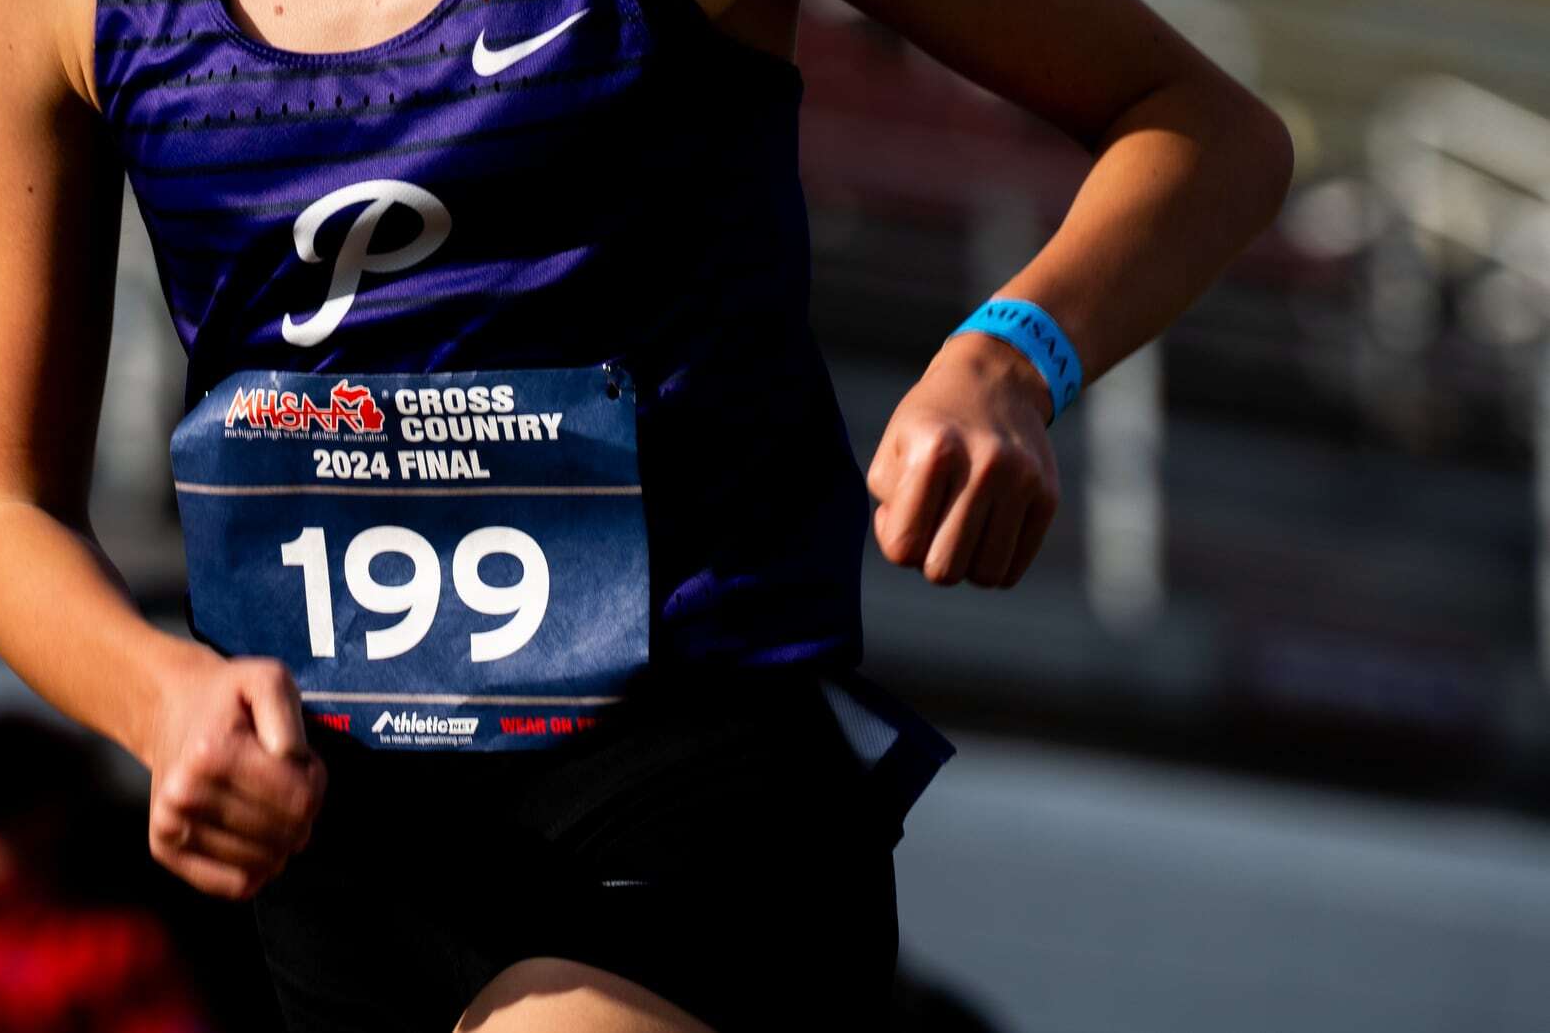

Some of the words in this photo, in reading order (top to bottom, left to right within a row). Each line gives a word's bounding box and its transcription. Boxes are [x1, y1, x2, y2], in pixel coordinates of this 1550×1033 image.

[281, 179, 451, 348] P
[225, 385, 364, 434] MHSAA
[394, 384, 515, 416] CROSS
[224, 427, 262, 442] michigan
[263, 428, 282, 442] high
[400, 412, 563, 444] COUNTRY
[313, 449, 391, 480] 2024
[397, 450, 491, 480] FINAL
[280, 524, 551, 664] 199
[500, 716, 547, 735] WEAR
[550, 716, 573, 735] ON
